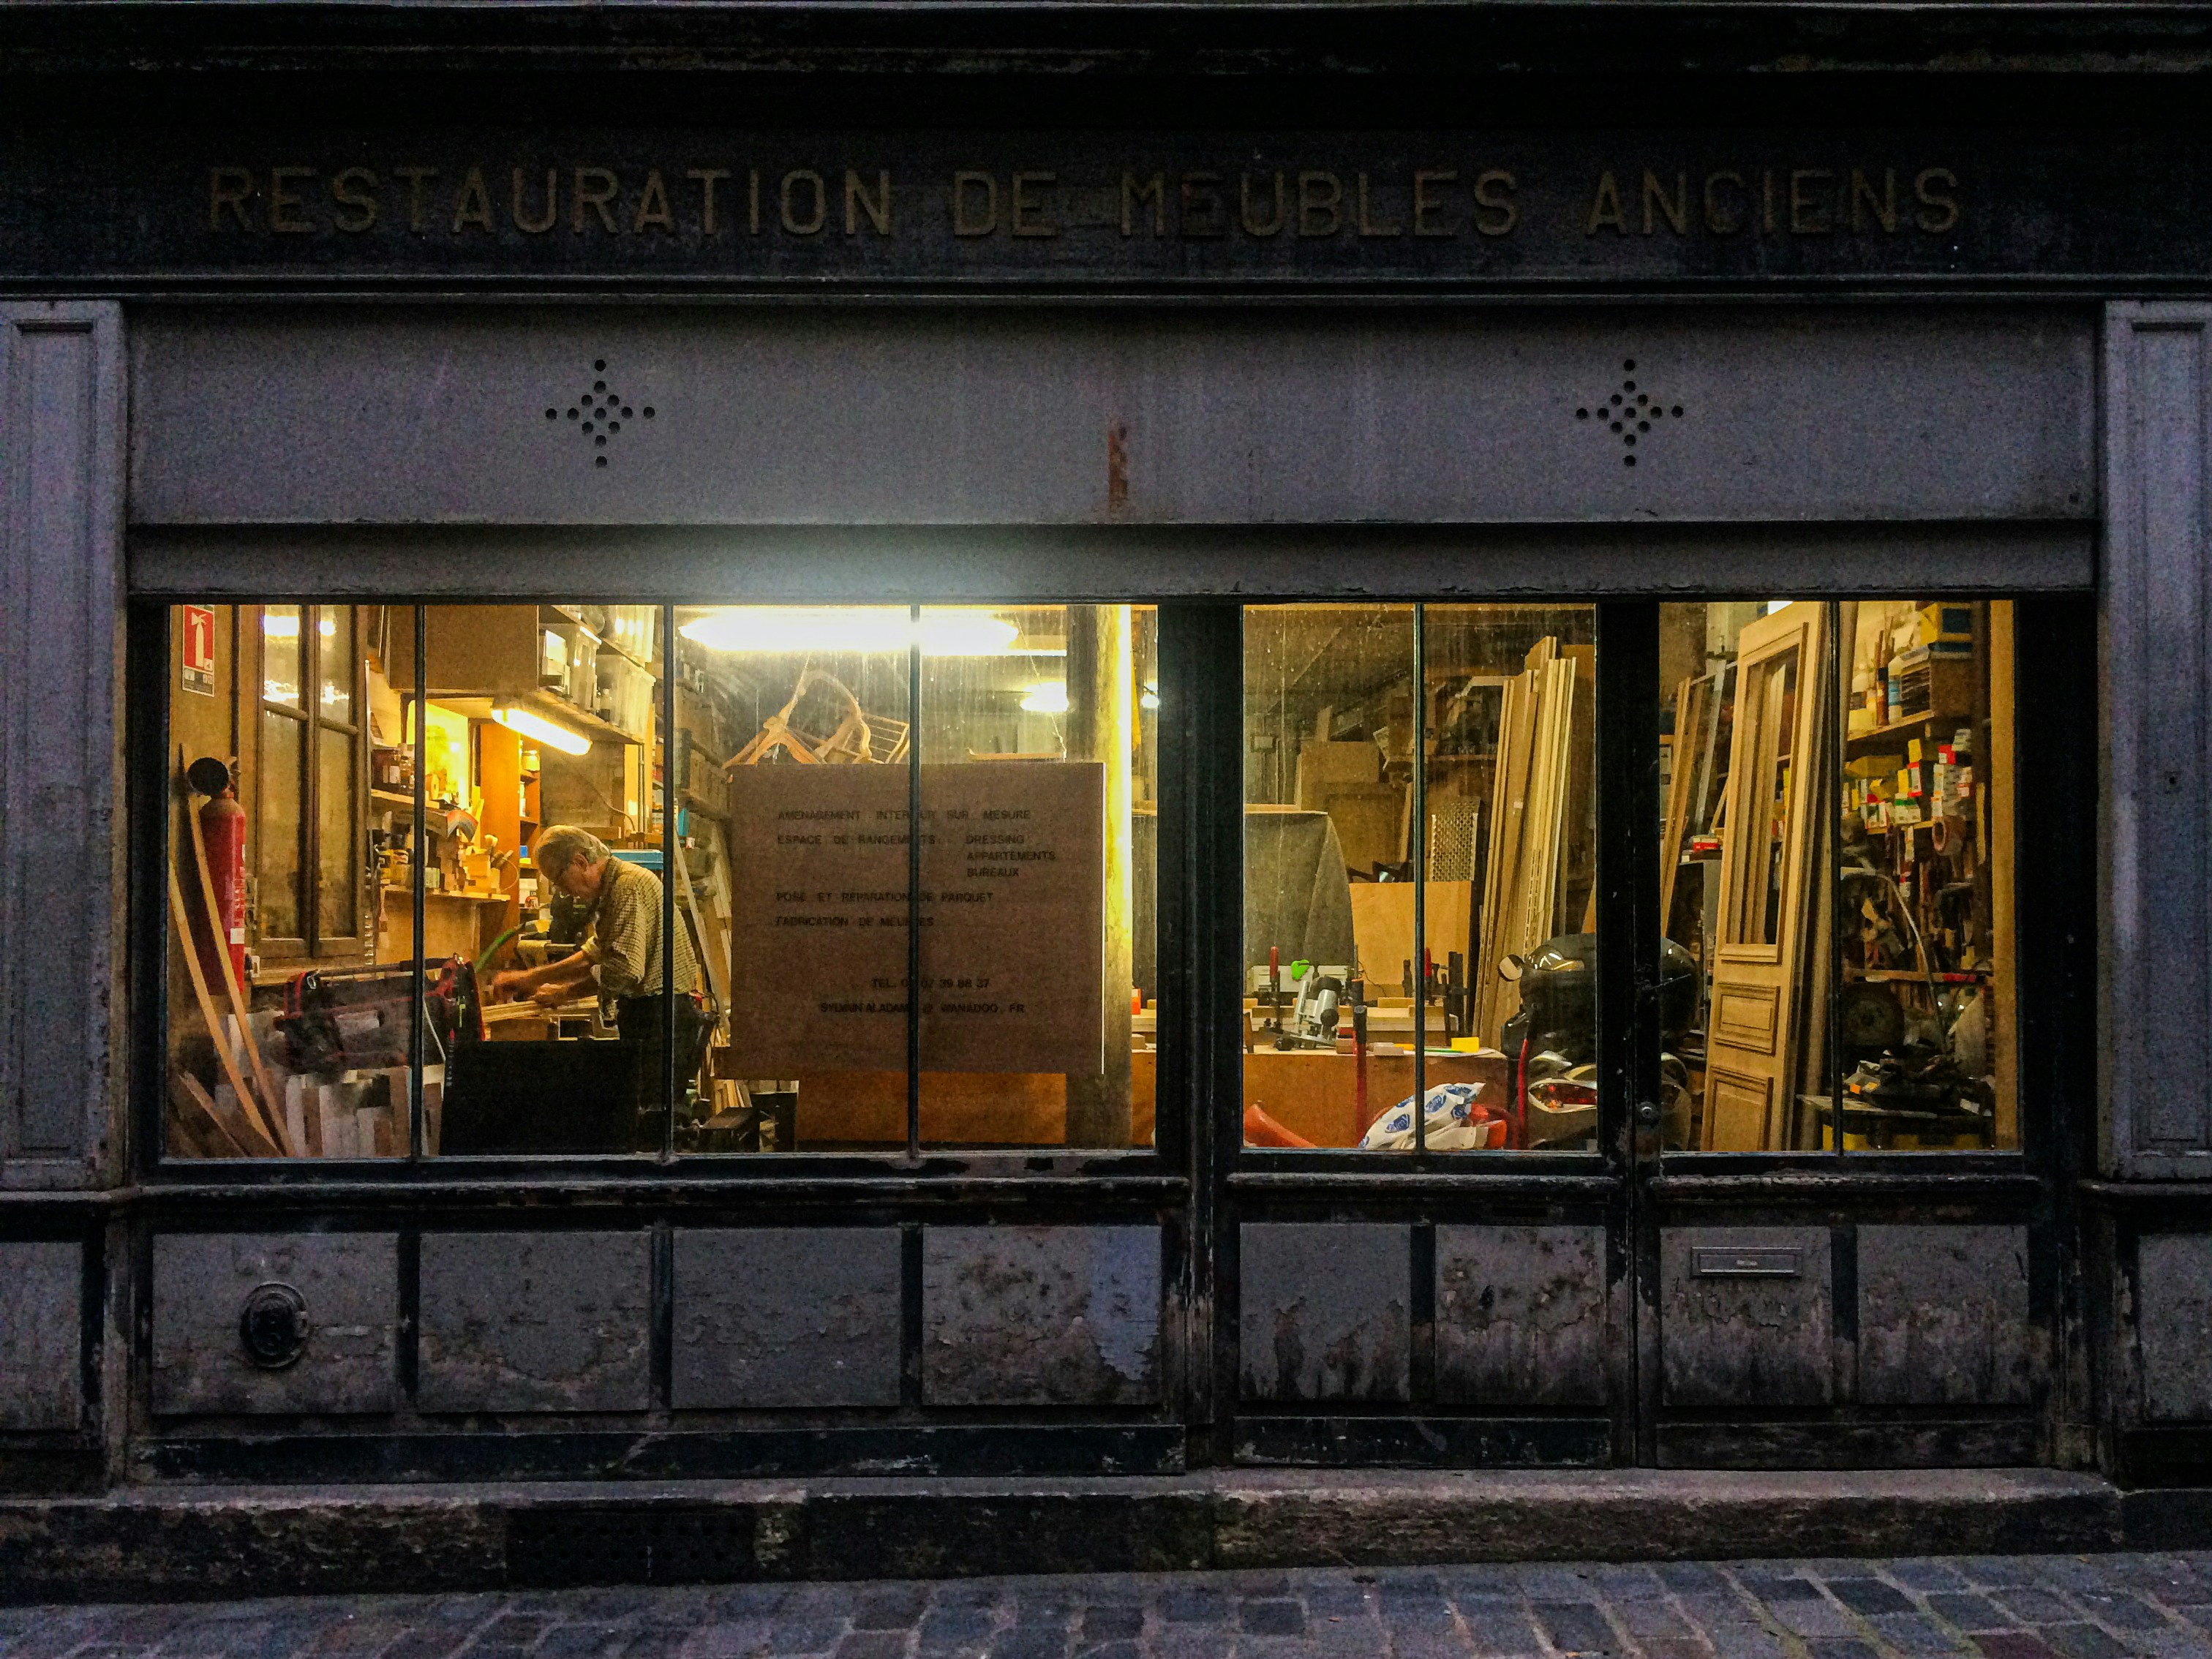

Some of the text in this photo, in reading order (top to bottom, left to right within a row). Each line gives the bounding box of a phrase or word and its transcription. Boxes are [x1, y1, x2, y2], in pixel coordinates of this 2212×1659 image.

[209, 166, 1960, 237] RESTAURATION DE MEUBLES ANCIENS
[876, 810, 935, 820] INTERUR
[947, 810, 968, 819] SUR
[983, 810, 1031, 820] MESURE
[778, 834, 1025, 844] ESPACE DE RANGEMETS DRESSING
[966, 851, 1056, 860] APPARTEMENTS
[967, 867, 1020, 878] BUREAUX
[817, 892, 832, 902] ET
[941, 892, 993, 903] PARQUET
[775, 917, 934, 927] FABRICATION DE MEUES
